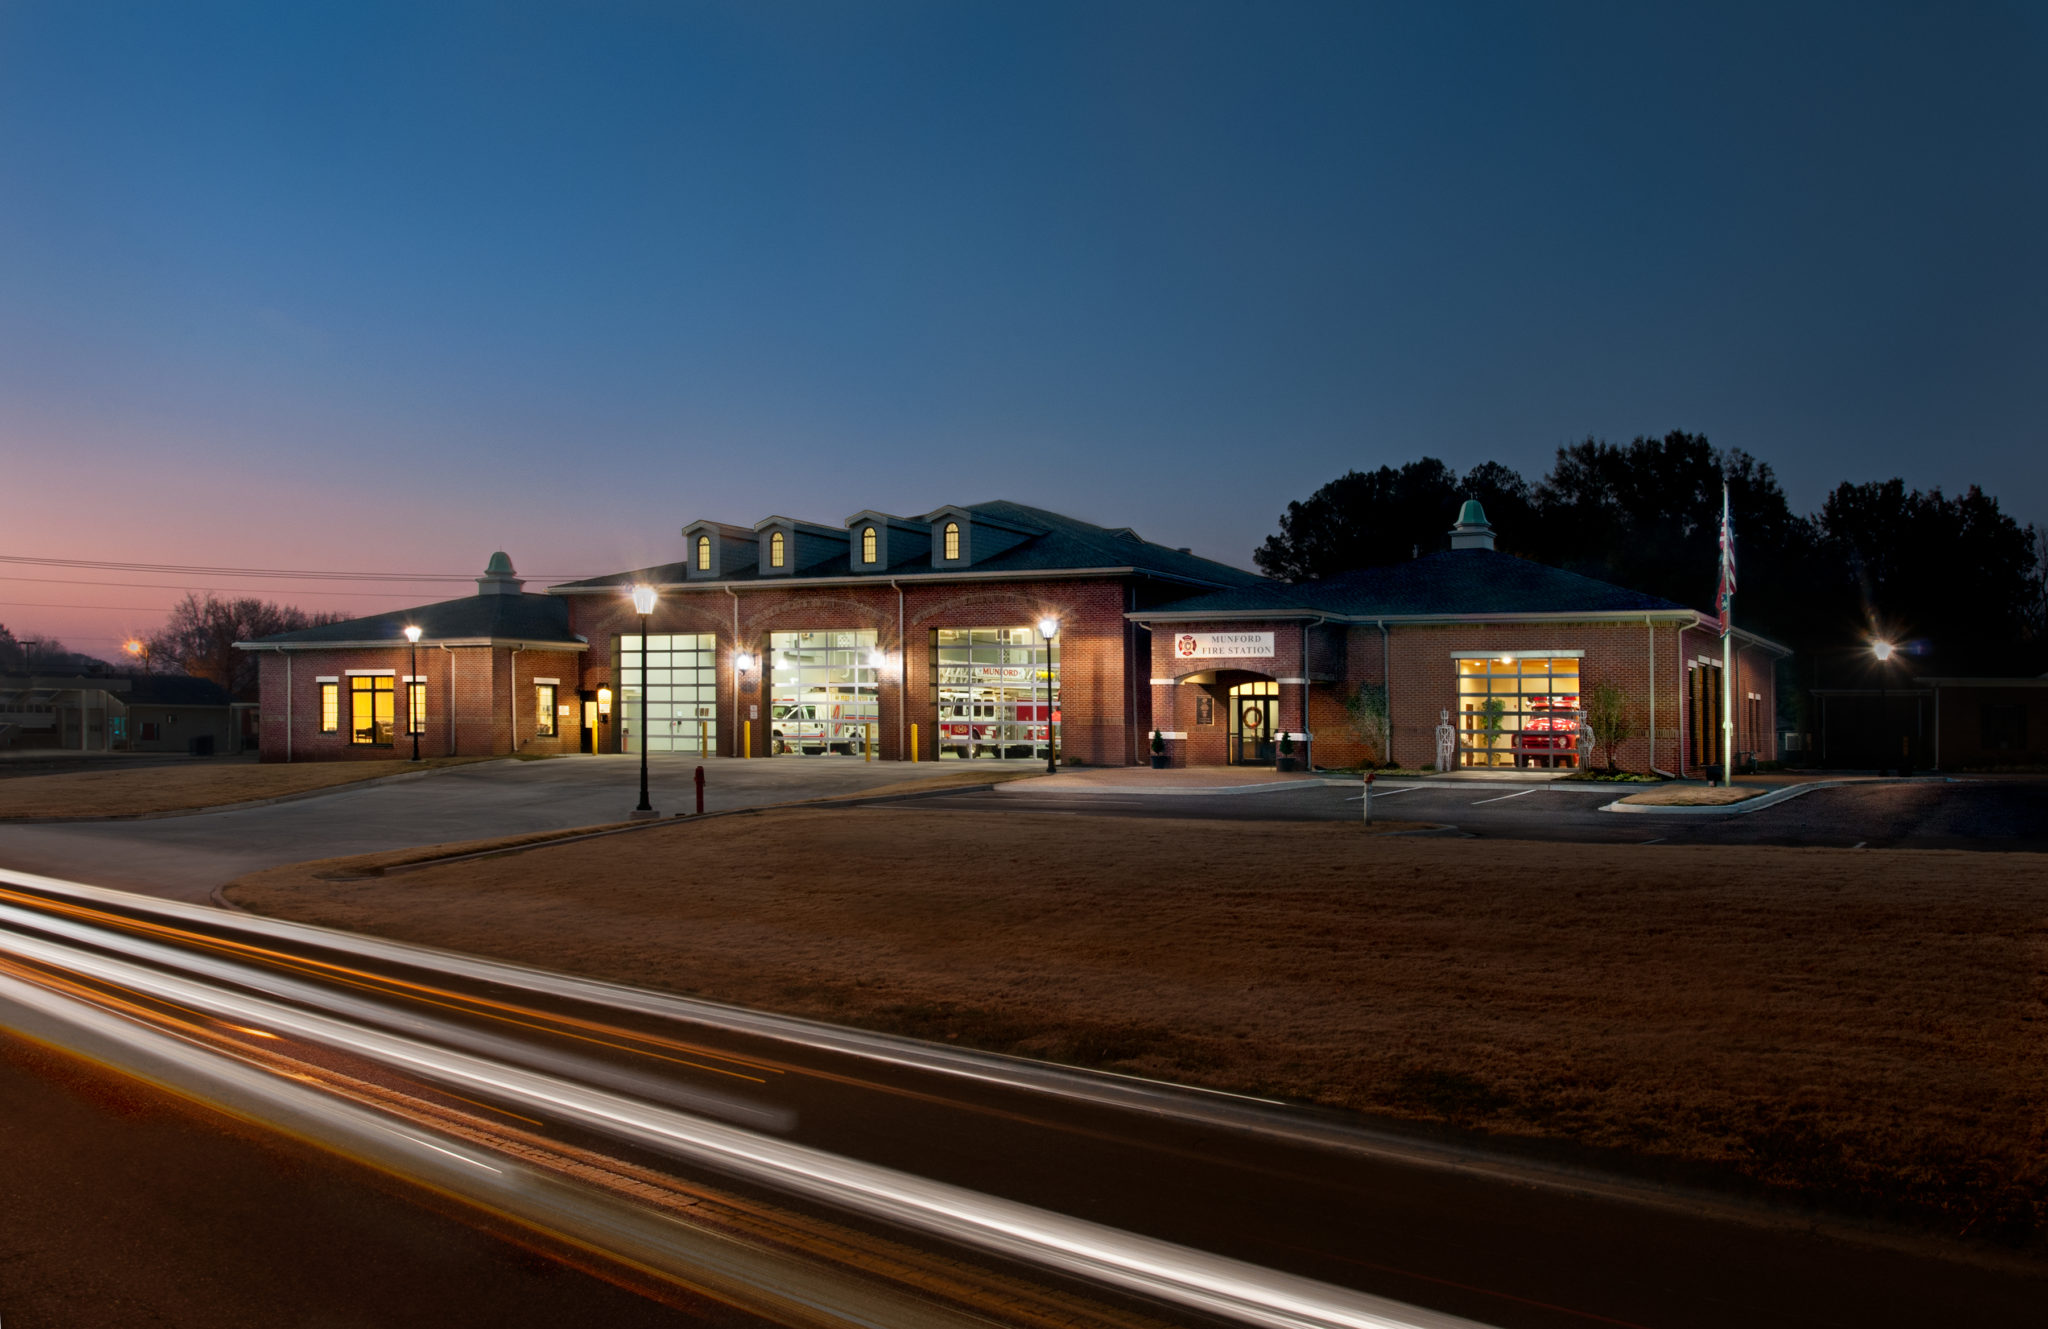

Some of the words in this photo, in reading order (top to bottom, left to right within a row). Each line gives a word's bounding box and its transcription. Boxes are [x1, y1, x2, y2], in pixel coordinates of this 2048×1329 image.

[1211, 635, 1262, 644] MUNFORD
[1202, 647, 1225, 655] FIRE
[1228, 646, 1272, 655] STATION
[983, 667, 1018, 677] MUNORD
